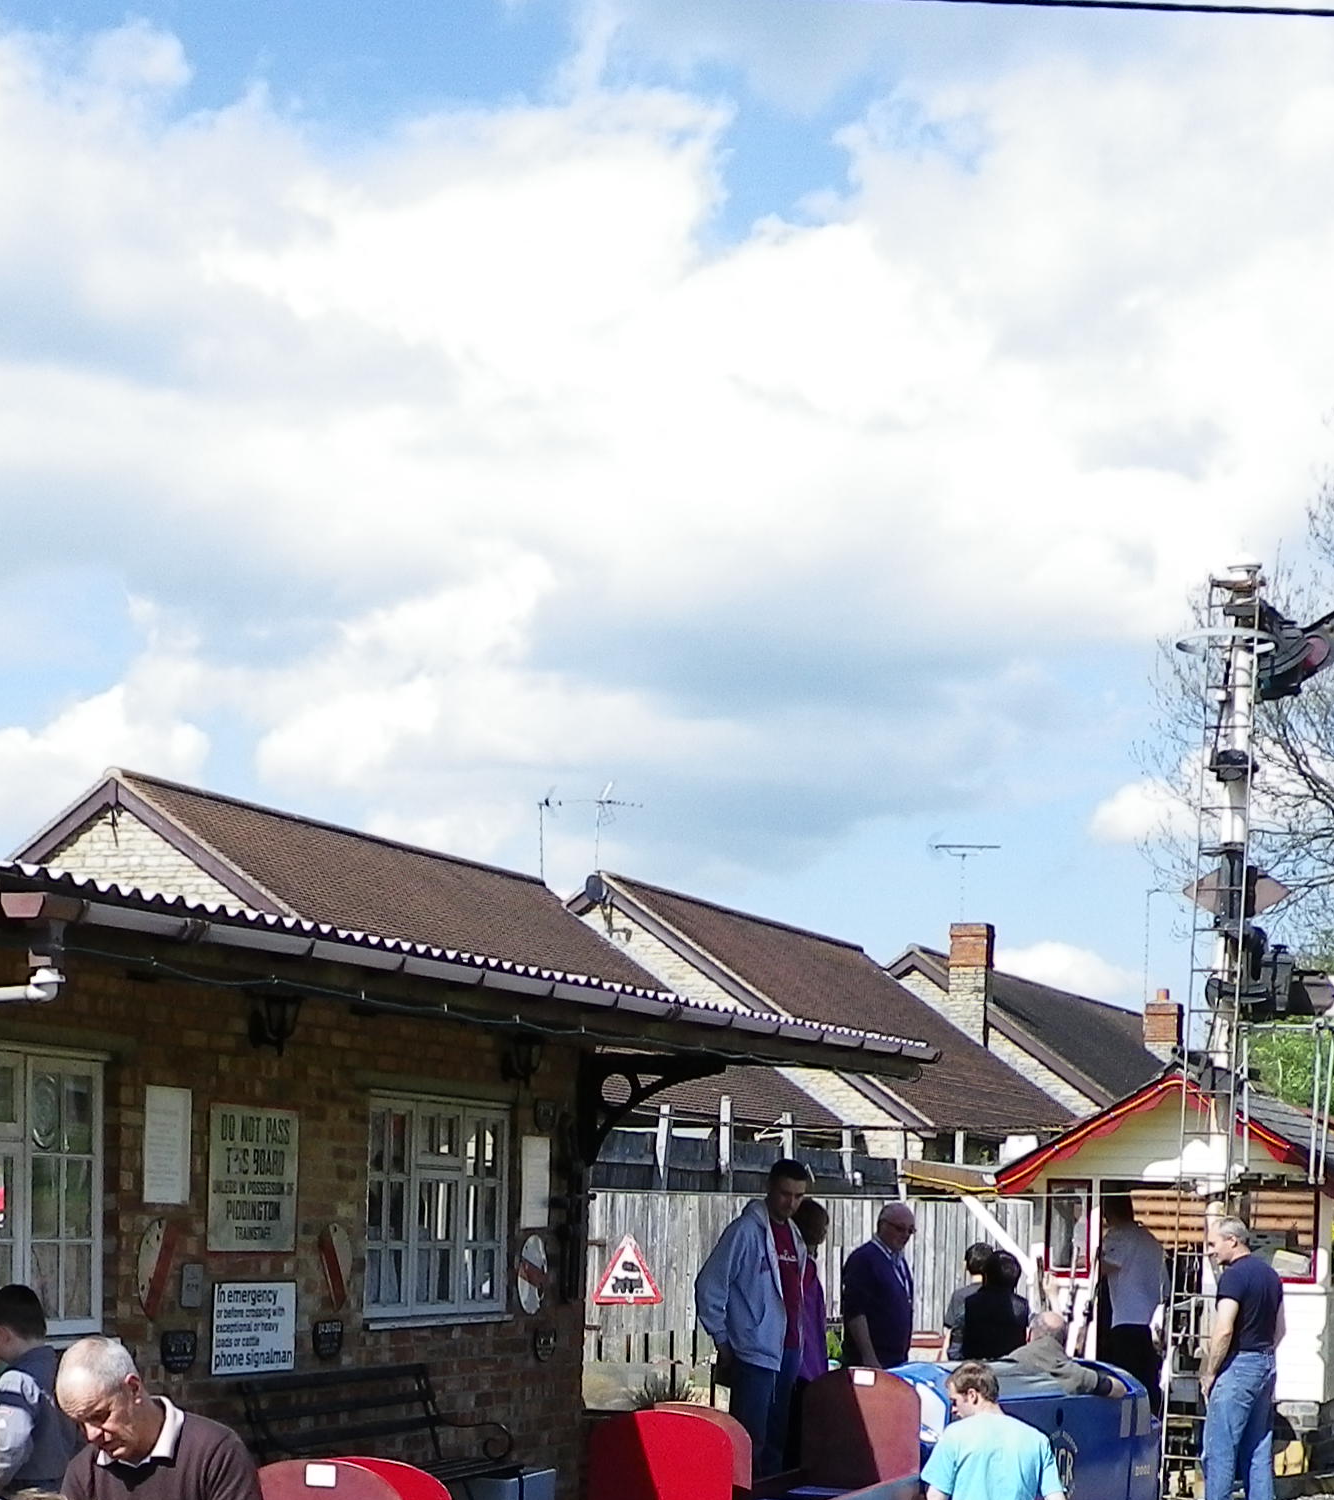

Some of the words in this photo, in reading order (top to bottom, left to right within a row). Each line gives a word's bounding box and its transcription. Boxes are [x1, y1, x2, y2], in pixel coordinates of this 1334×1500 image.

[221, 1113, 235, 1141] DO
[241, 1115, 261, 1143] NOT
[266, 1117, 290, 1145] PASS
[253, 1148, 285, 1176] BOARD
[239, 1181, 246, 1195] IN
[248, 1181, 285, 1195] POSSESSION
[226, 1200, 281, 1221] PIDDINGTON
[217, 1285, 226, 1303] In
[227, 1289, 278, 1306] emergency
[216, 1309, 223, 1318] or
[224, 1307, 244, 1318] before
[245, 1307, 271, 1319] crossing
[272, 1306, 285, 1317] with
[215, 1321, 253, 1334] exceptional
[253, 1323, 260, 1332] or
[261, 1322, 279, 1333] heavy
[215, 1336, 232, 1348] loads
[233, 1338, 241, 1347] or
[242, 1336, 259, 1347] cattle
[214, 1351, 244, 1370] phone
[245, 1348, 293, 1368] signalman
